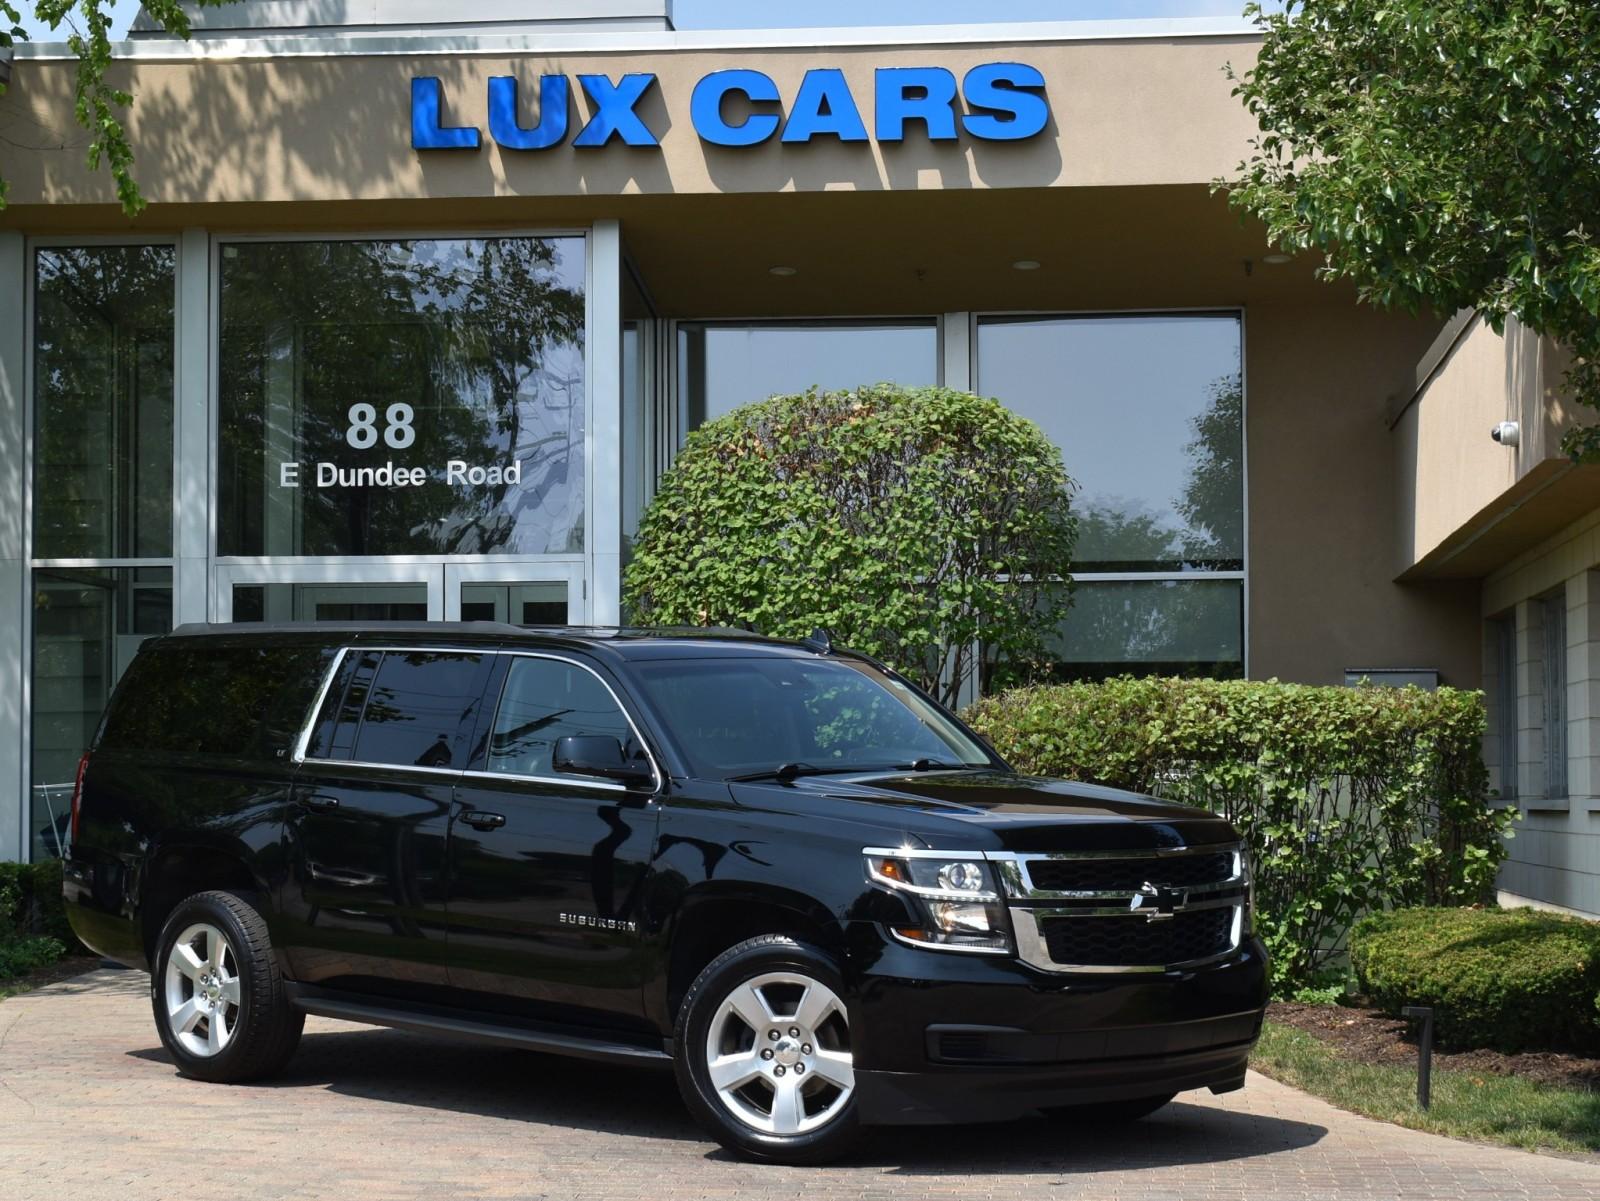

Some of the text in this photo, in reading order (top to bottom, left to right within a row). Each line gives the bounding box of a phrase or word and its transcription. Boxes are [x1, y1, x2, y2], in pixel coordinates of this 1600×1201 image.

[411, 62, 1048, 151] LUX CARS
[346, 403, 416, 449] 88
[280, 460, 521, 488] E Dundee Road
[559, 913, 636, 932] SUBURBAN
